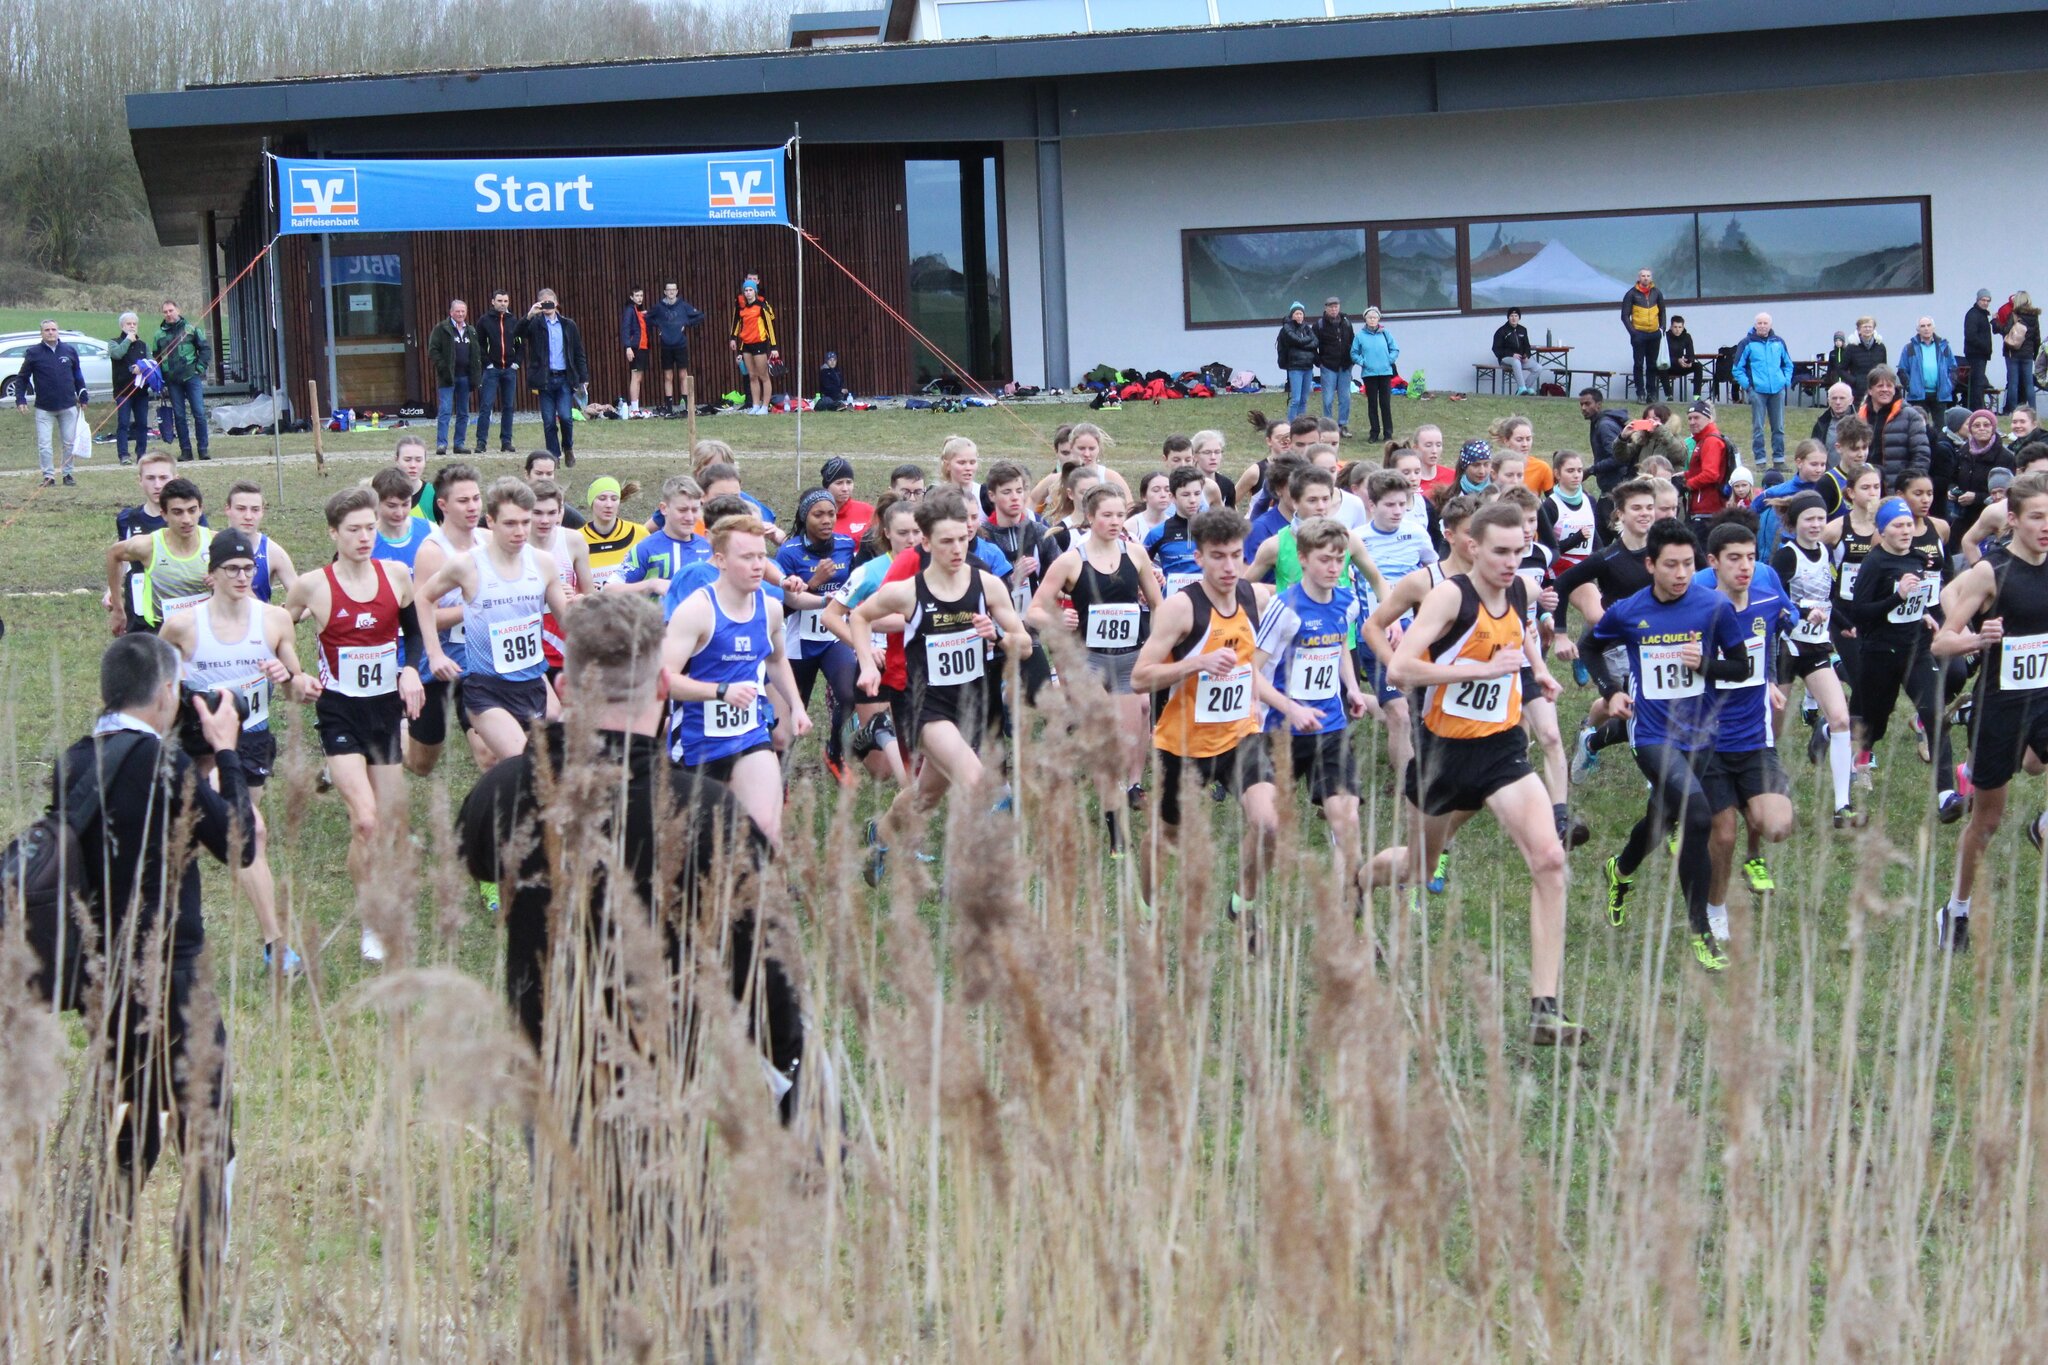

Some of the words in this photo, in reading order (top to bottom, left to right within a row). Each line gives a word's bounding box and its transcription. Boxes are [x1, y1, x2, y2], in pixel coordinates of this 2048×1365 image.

[474, 173, 594, 213] Start
[709, 208, 776, 219] Raiffeisenbank
[291, 217, 359, 227] Raiffeisenbank
[593, 571, 613, 579] ARGER
[170, 600, 199, 611] KARGER
[493, 597, 514, 606] TELIS
[498, 624, 528, 636] KARGER
[1096, 619, 1130, 640] 489
[934, 638, 966, 648] KARGER
[1642, 635, 1661, 645] LAC
[1662, 631, 1703, 644] QUELE
[503, 633, 536, 663] 395
[2012, 641, 2042, 651] KARGER
[348, 652, 380, 660] KARGER
[938, 647, 975, 676] 300
[1649, 651, 1682, 660] KARGER
[208, 660, 231, 669] TELIS
[236, 658, 267, 666] FINA
[2013, 652, 2048, 681] 507
[357, 663, 382, 688] 64
[1304, 664, 1333, 690] 142
[1653, 663, 1693, 689] 139
[1207, 684, 1244, 712] 202
[1455, 680, 1501, 712] 203
